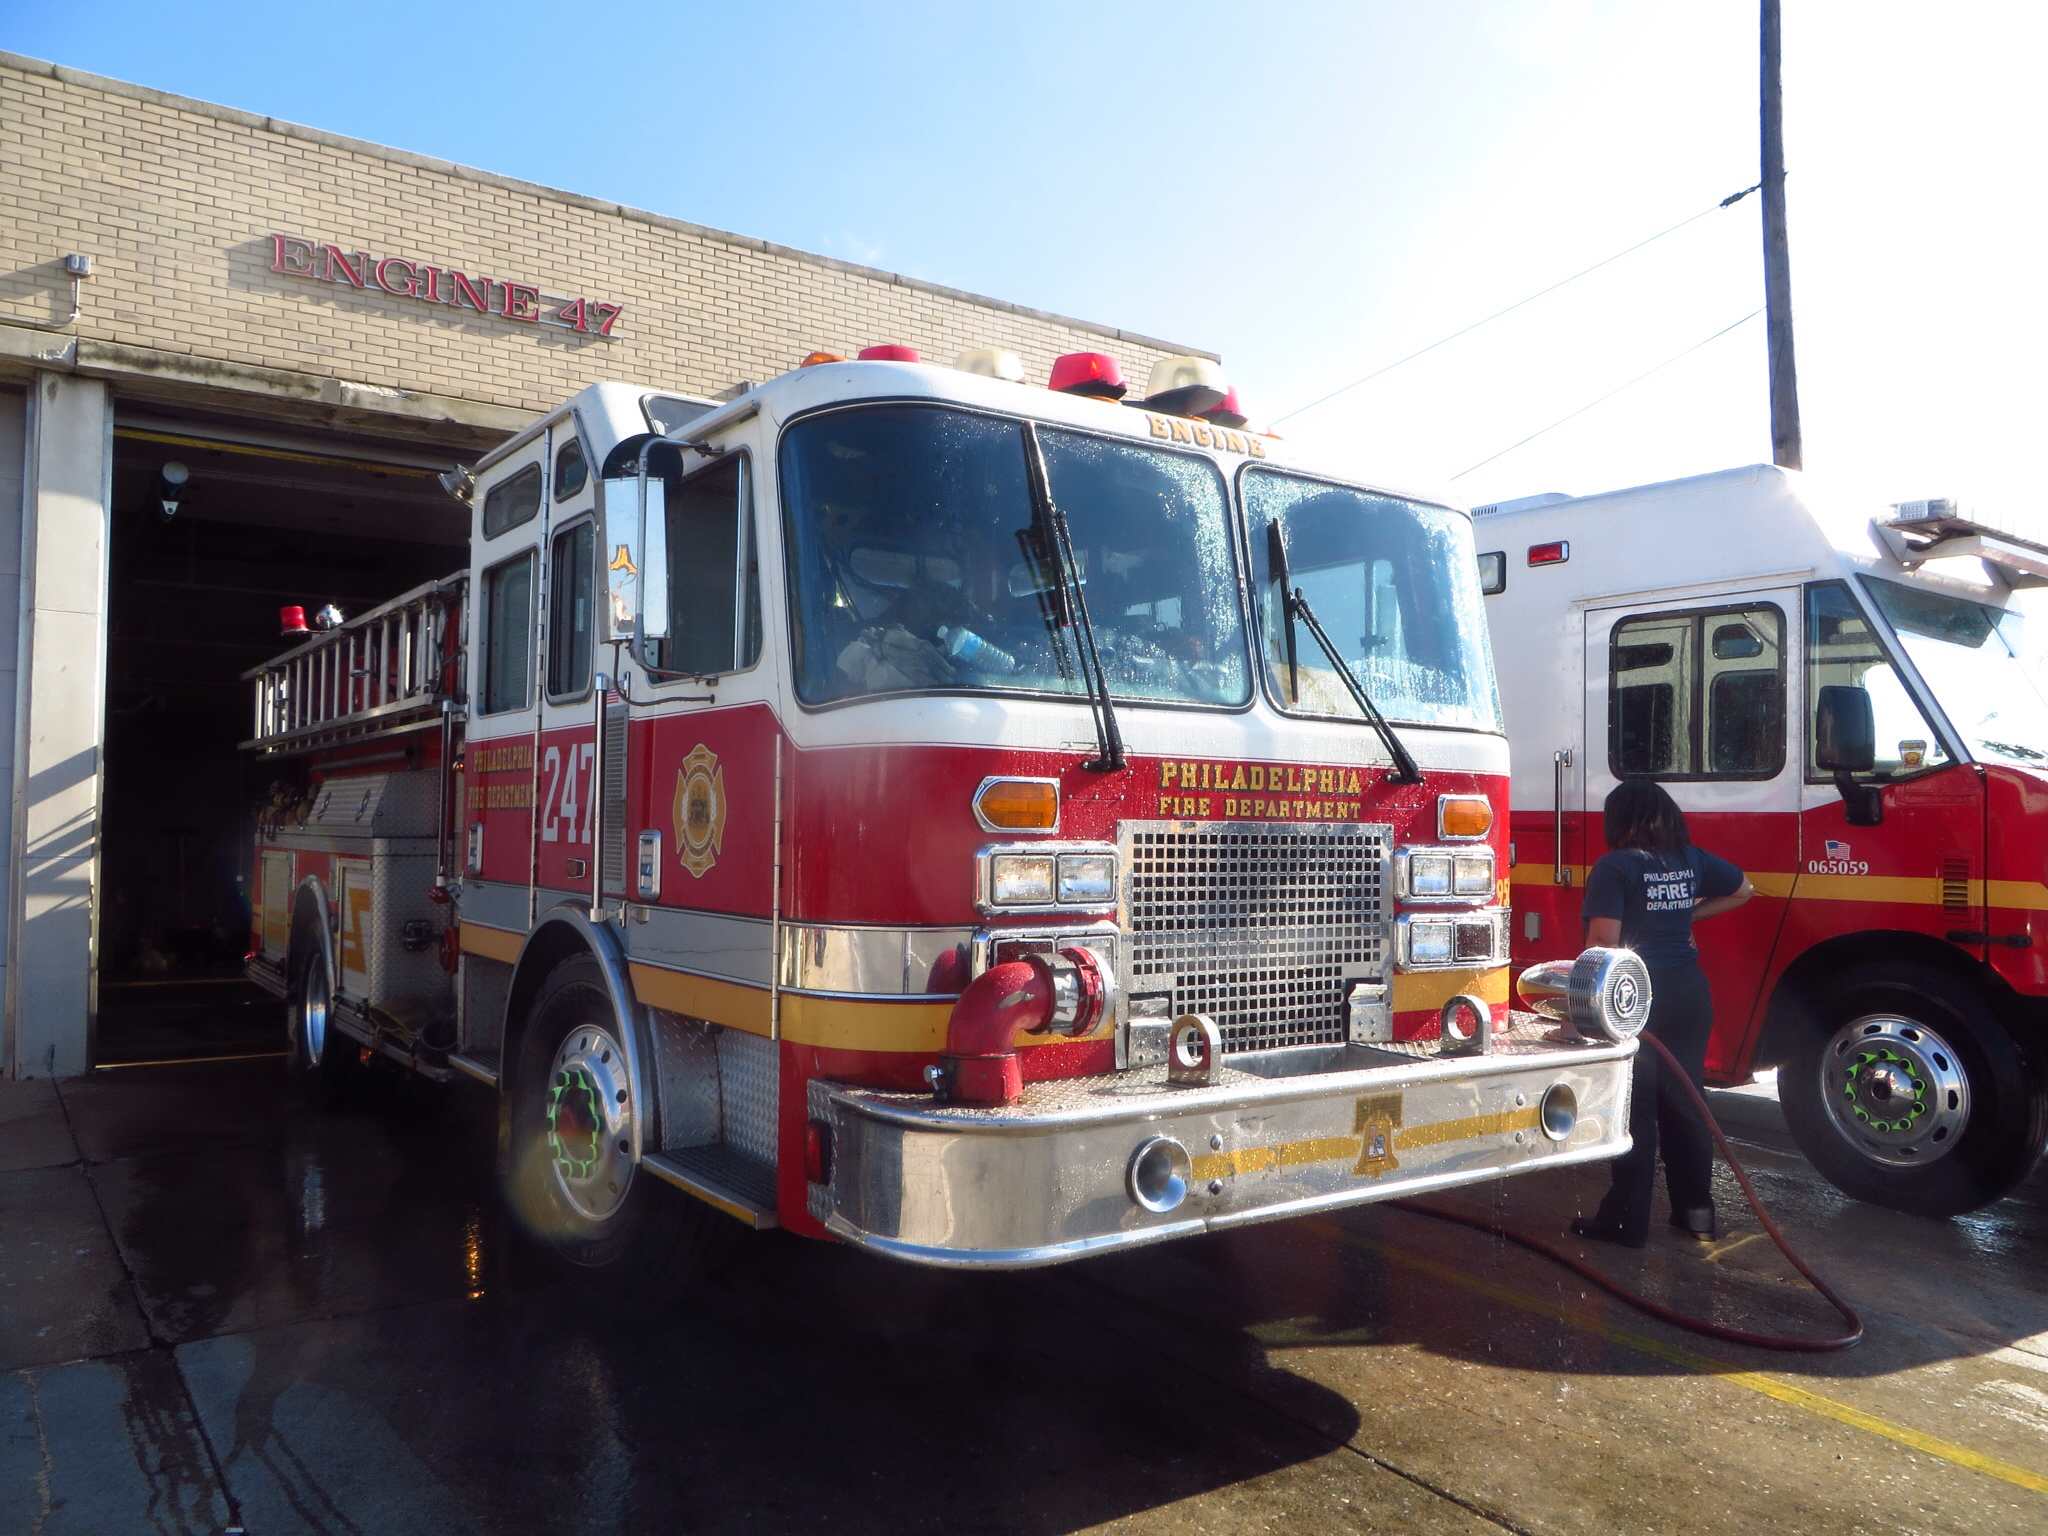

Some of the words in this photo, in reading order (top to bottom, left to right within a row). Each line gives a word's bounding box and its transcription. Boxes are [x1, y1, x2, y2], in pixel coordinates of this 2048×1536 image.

[270, 233, 540, 322] ENGINE
[559, 297, 624, 336] 47
[1145, 414, 1265, 459] ENGINE
[542, 743, 596, 844] 247
[1160, 761, 1361, 794] PHILADELPHIA
[1158, 797, 1210, 817] FIRE
[1225, 798, 1361, 820] DEPARTMENT
[1808, 860, 1869, 875] 065059
[1657, 882, 1689, 900] FIRE
